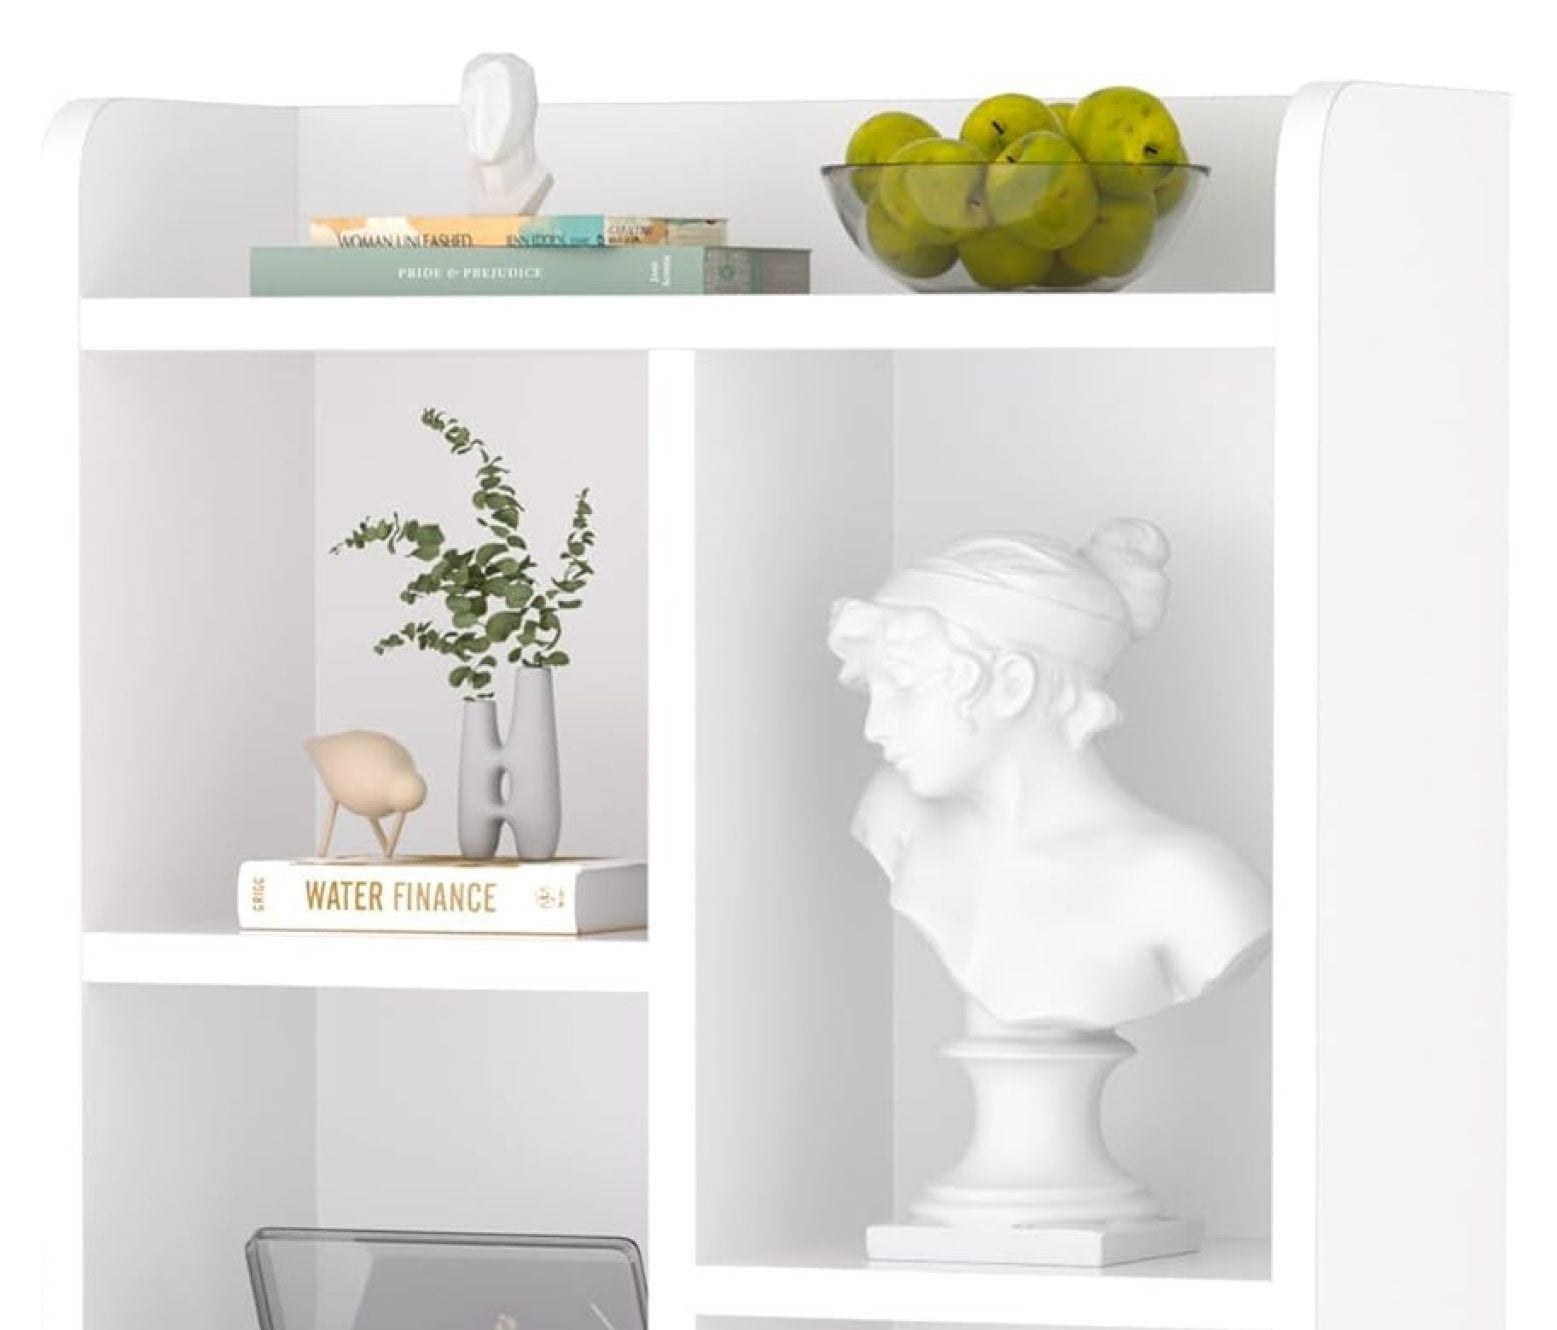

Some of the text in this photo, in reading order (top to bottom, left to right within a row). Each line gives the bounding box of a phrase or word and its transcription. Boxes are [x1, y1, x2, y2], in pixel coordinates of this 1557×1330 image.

[398, 267, 543, 280] PRIDE & PREJUDICE
[252, 876, 265, 912] GRIGG
[306, 880, 497, 912] WATER FINANCE
